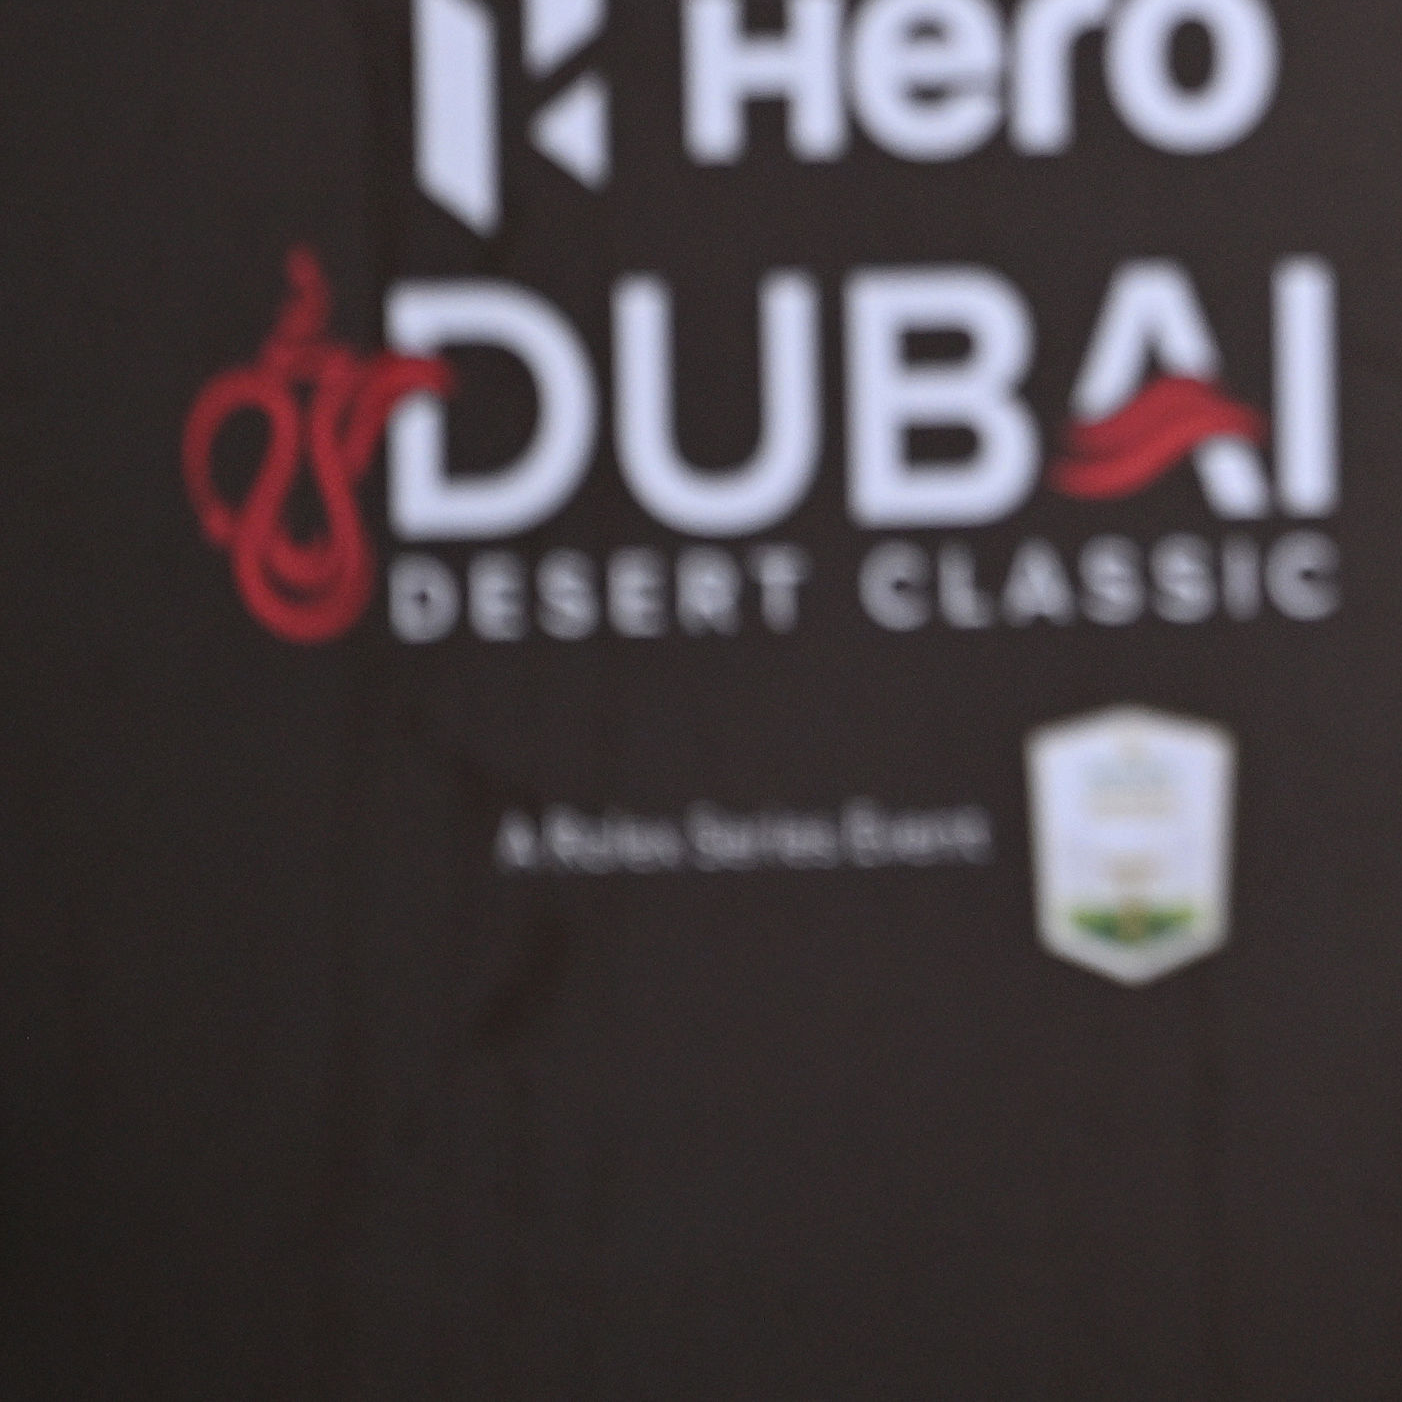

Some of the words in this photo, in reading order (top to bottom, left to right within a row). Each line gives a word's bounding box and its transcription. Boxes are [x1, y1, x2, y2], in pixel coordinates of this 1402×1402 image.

[386, 256, 1338, 541] DUBAI
[389, 548, 804, 642] DESERT
[859, 531, 1337, 632] CLASSIC
